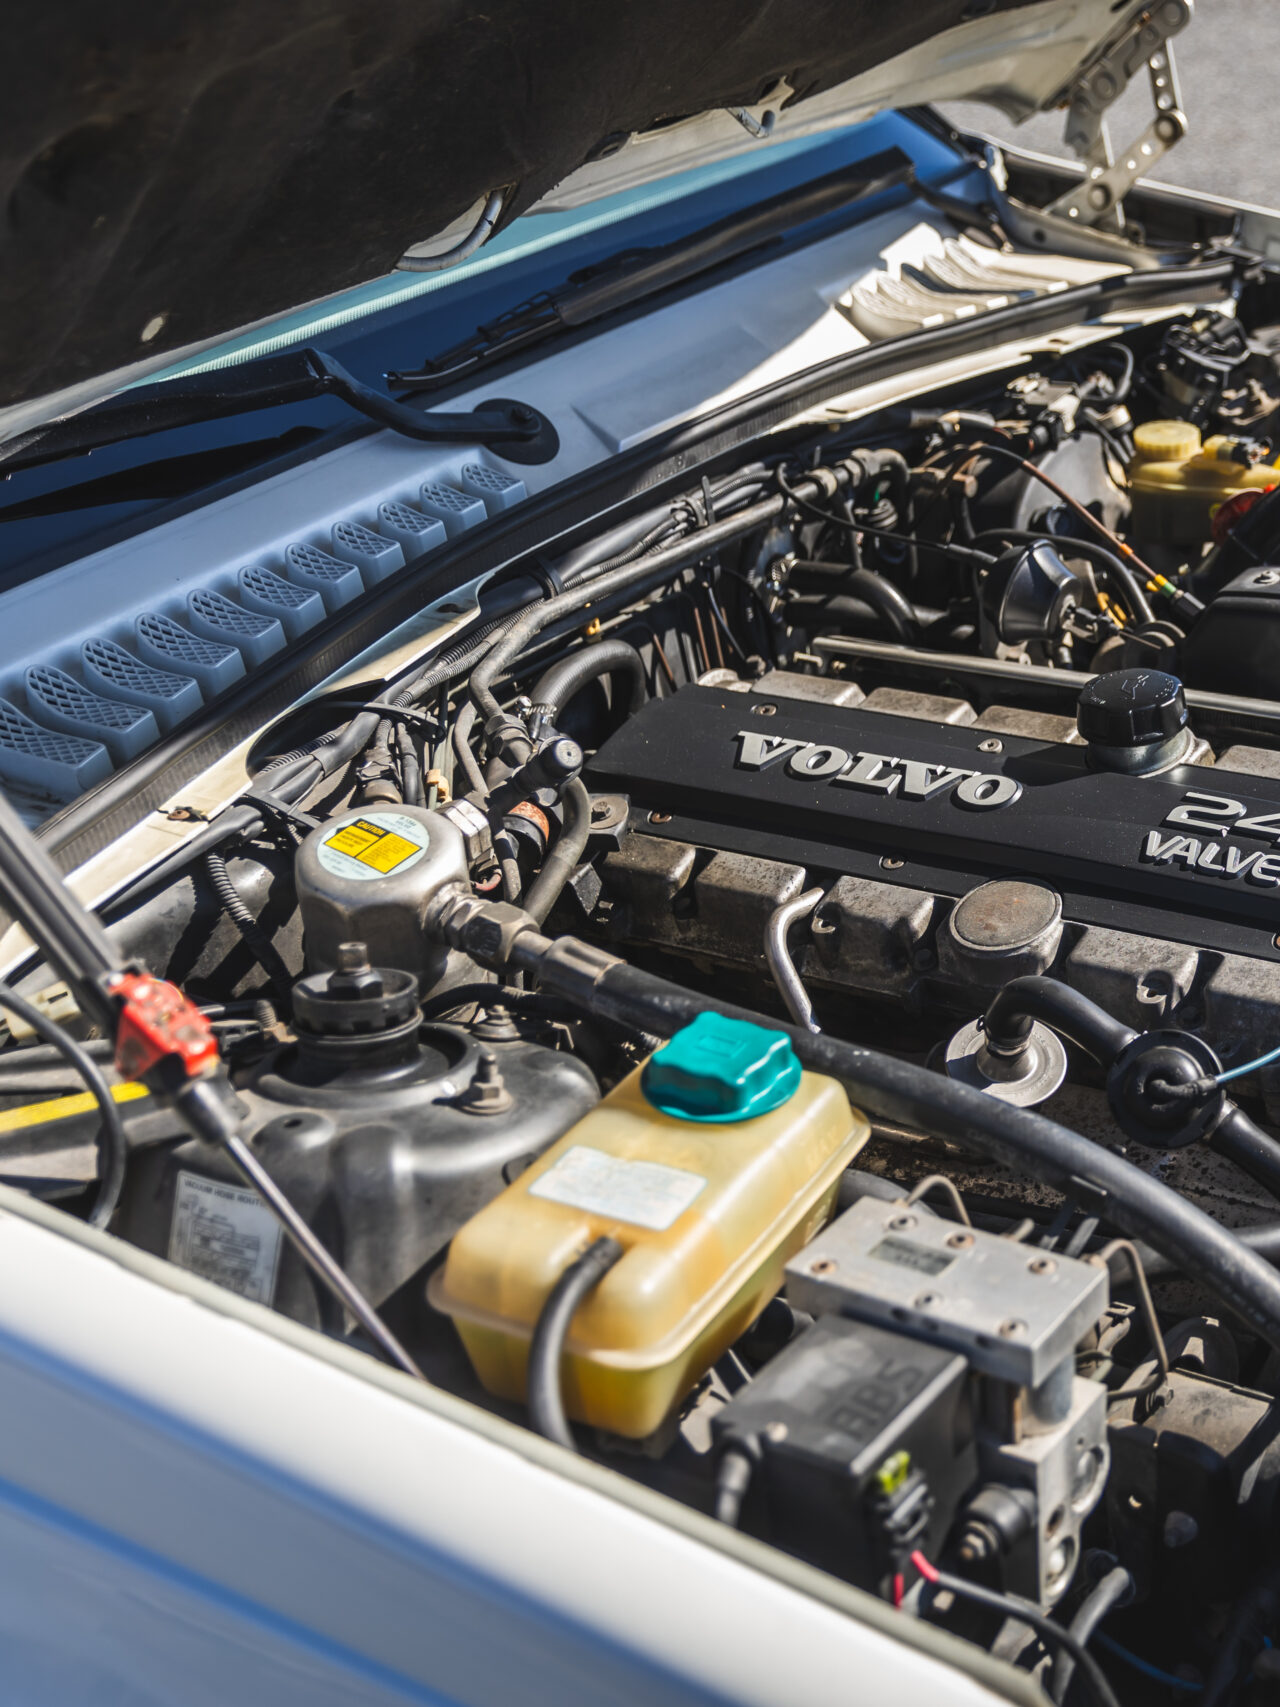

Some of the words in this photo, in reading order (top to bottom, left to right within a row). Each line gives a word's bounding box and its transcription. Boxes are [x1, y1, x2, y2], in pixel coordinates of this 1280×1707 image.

[737, 731, 1022, 809] VOLVO
[356, 821, 386, 836] CAUTION
[184, 1179, 213, 1194] VACUUM
[214, 1186, 235, 1200] HOSE
[237, 1193, 261, 1206] ROUT
[829, 1358, 924, 1440] ABS
